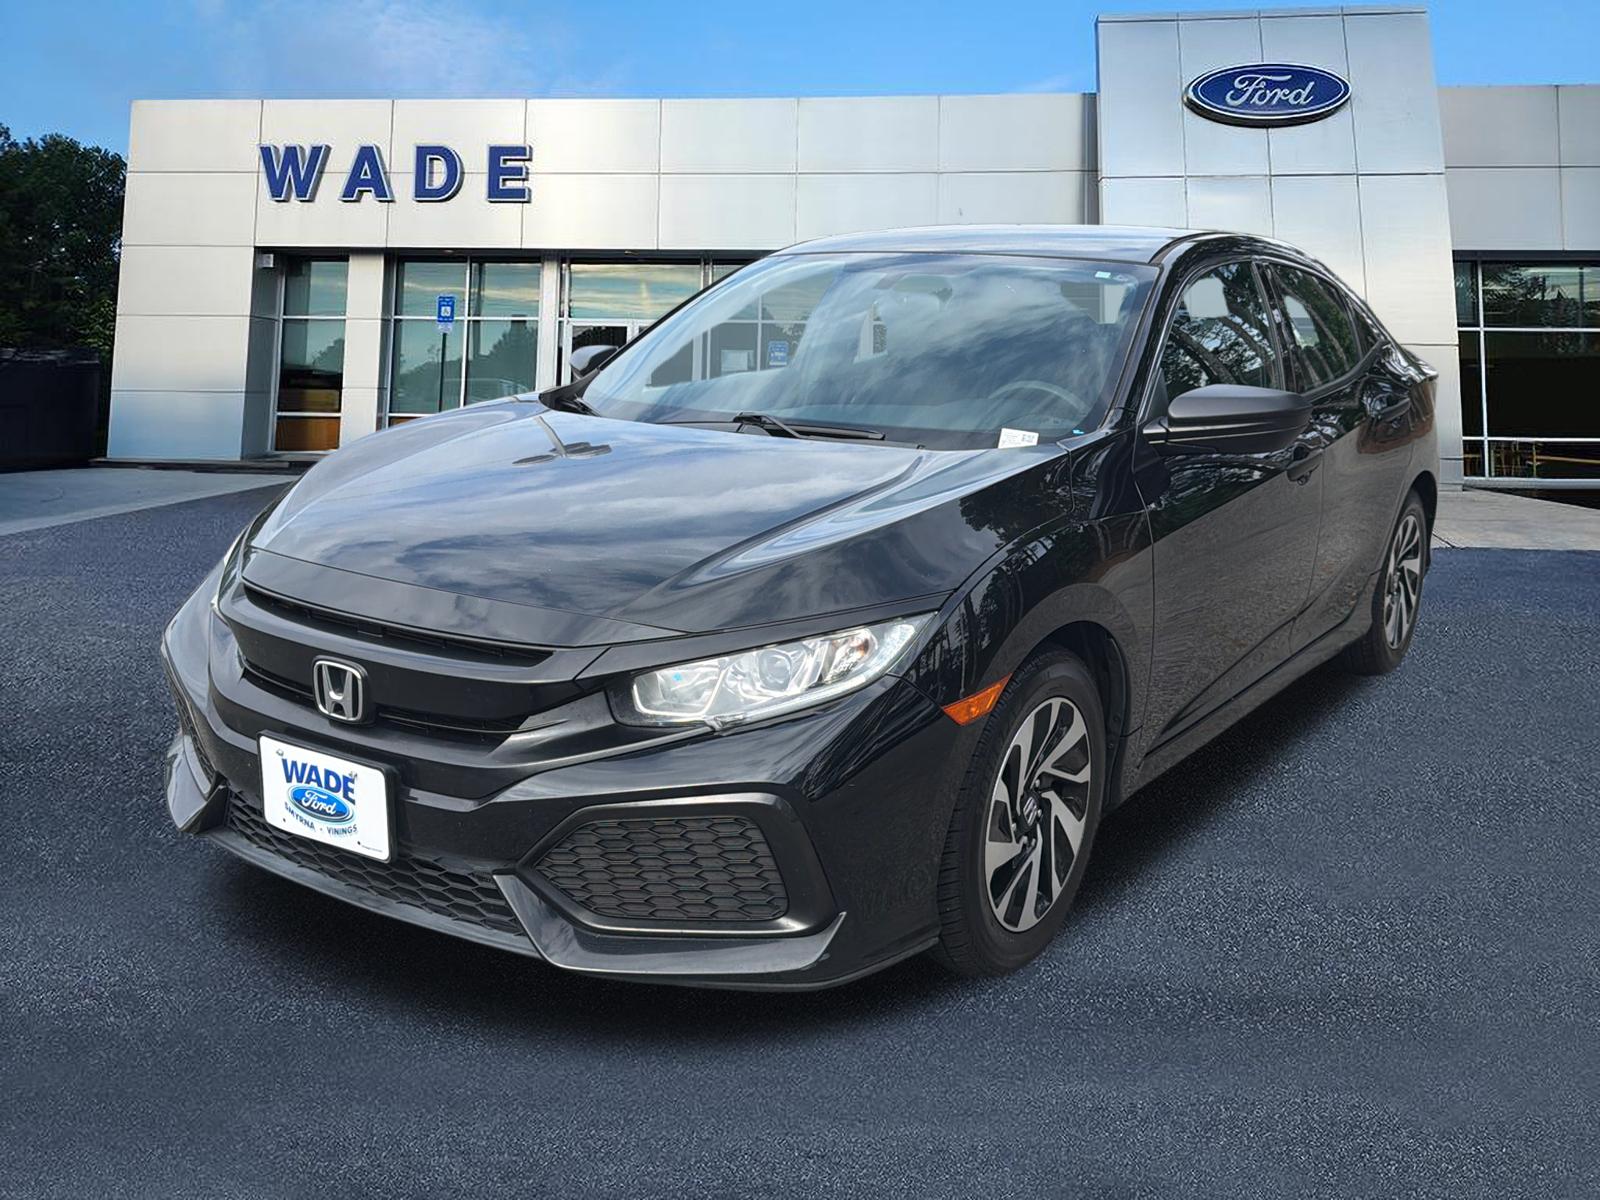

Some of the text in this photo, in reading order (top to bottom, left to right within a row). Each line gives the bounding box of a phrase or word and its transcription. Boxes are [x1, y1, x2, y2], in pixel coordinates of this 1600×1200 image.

[1225, 74, 1315, 107] Ford
[258, 144, 532, 203] WADE
[281, 757, 356, 806] WADE
[284, 801, 358, 835] SMYRNA VININGS
[301, 790, 337, 815] Ford
